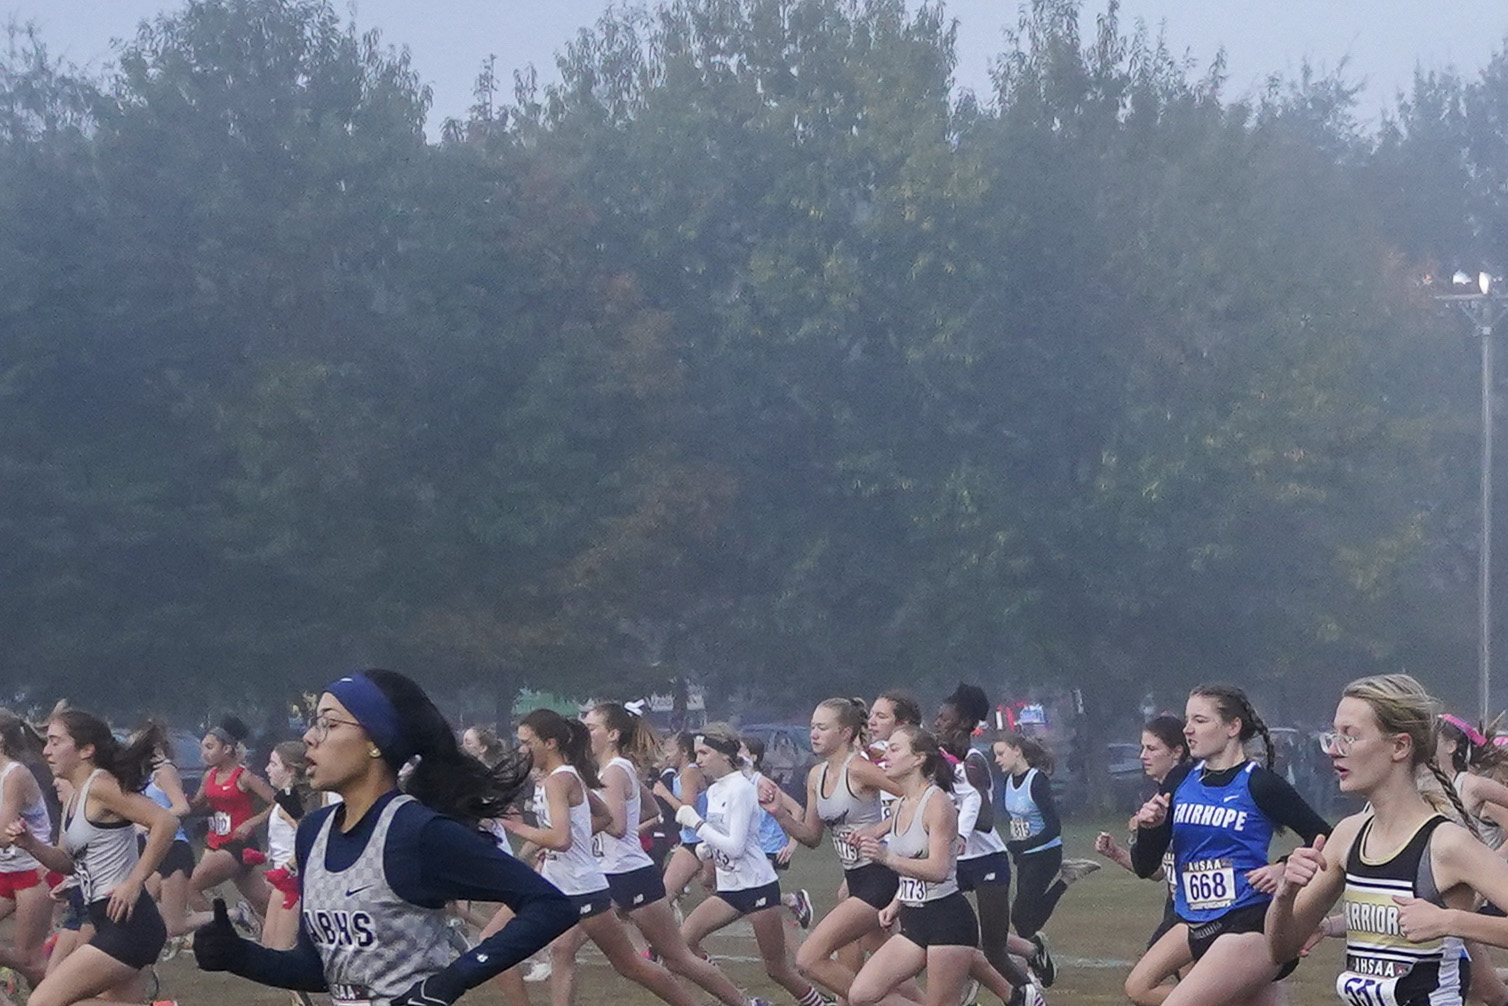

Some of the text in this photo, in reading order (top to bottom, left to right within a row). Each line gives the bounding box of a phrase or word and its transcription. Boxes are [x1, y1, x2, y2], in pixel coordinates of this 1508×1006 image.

[1174, 803, 1248, 831] FAIRHOPE
[1188, 858, 1222, 872] AHSAA
[1190, 872, 1227, 900] 668
[1355, 958, 1396, 977] AHSAA
